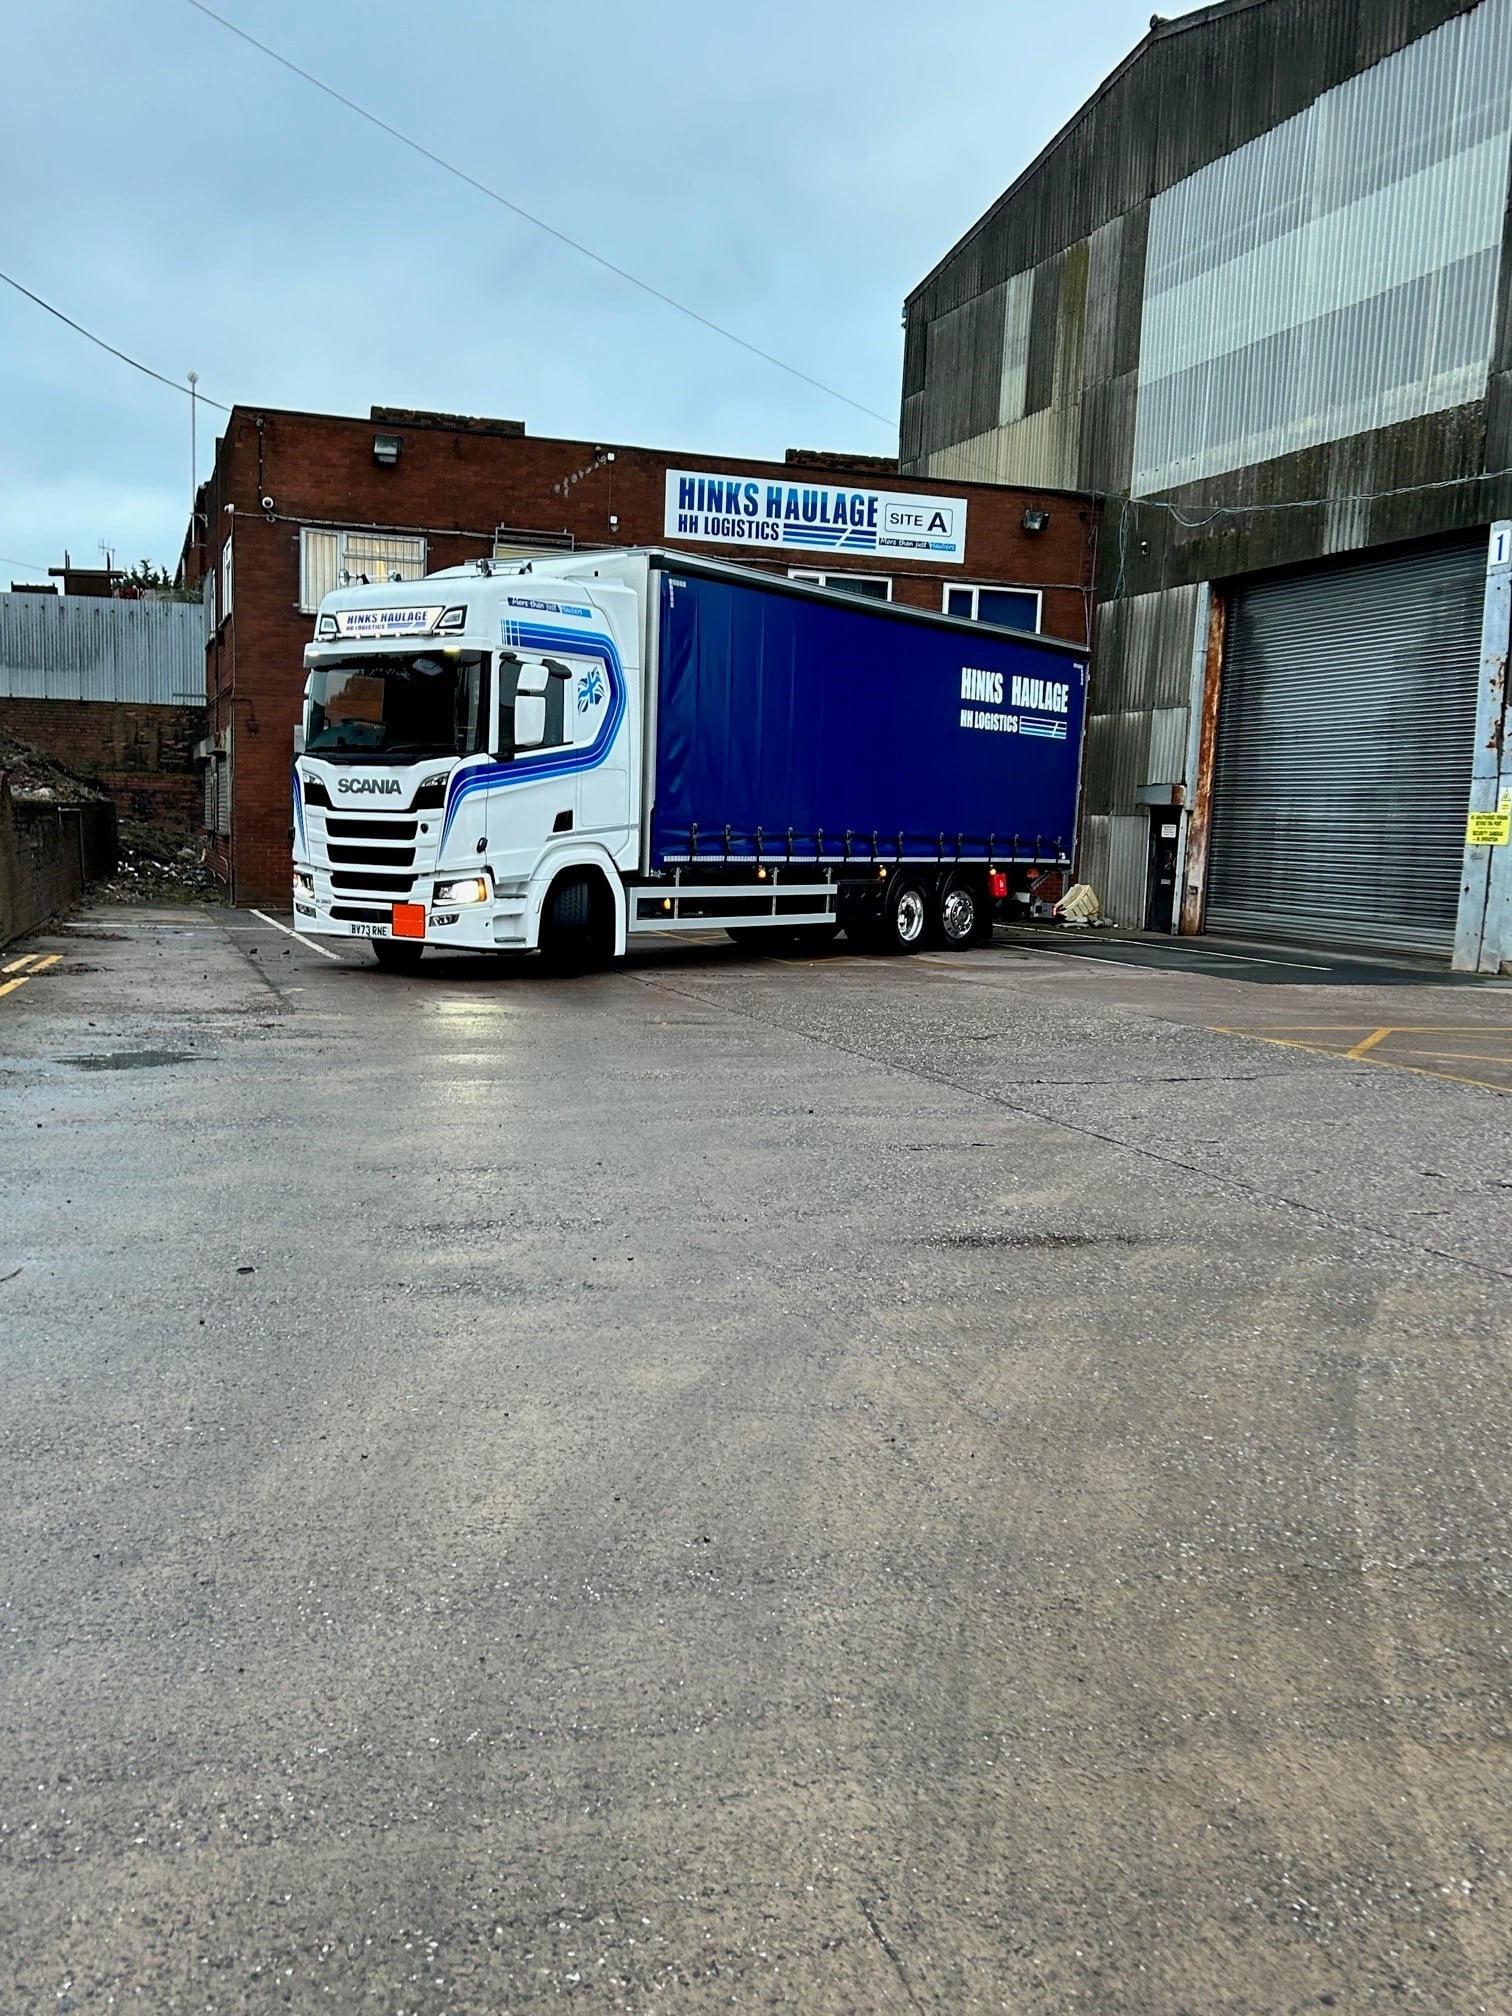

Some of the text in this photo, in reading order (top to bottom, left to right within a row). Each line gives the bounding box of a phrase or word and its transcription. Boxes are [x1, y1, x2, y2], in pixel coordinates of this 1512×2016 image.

[679, 477, 879, 528] HINKS HAULAGE
[678, 513, 780, 541] HH LOGISTICS
[890, 511, 947, 533] SITE A
[879, 538, 897, 546] More
[898, 539, 914, 548] than
[1497, 534, 1504, 561] 1
[512, 598, 529, 607] More
[530, 600, 545, 609] than
[347, 611, 428, 624] HINKS HAULAGE
[961, 667, 1069, 713] HINKS HAULAGE
[960, 709, 1018, 733] HH LOGISTICS
[337, 778, 402, 795] SCANIA
[351, 924, 387, 937] BV73 RNE
